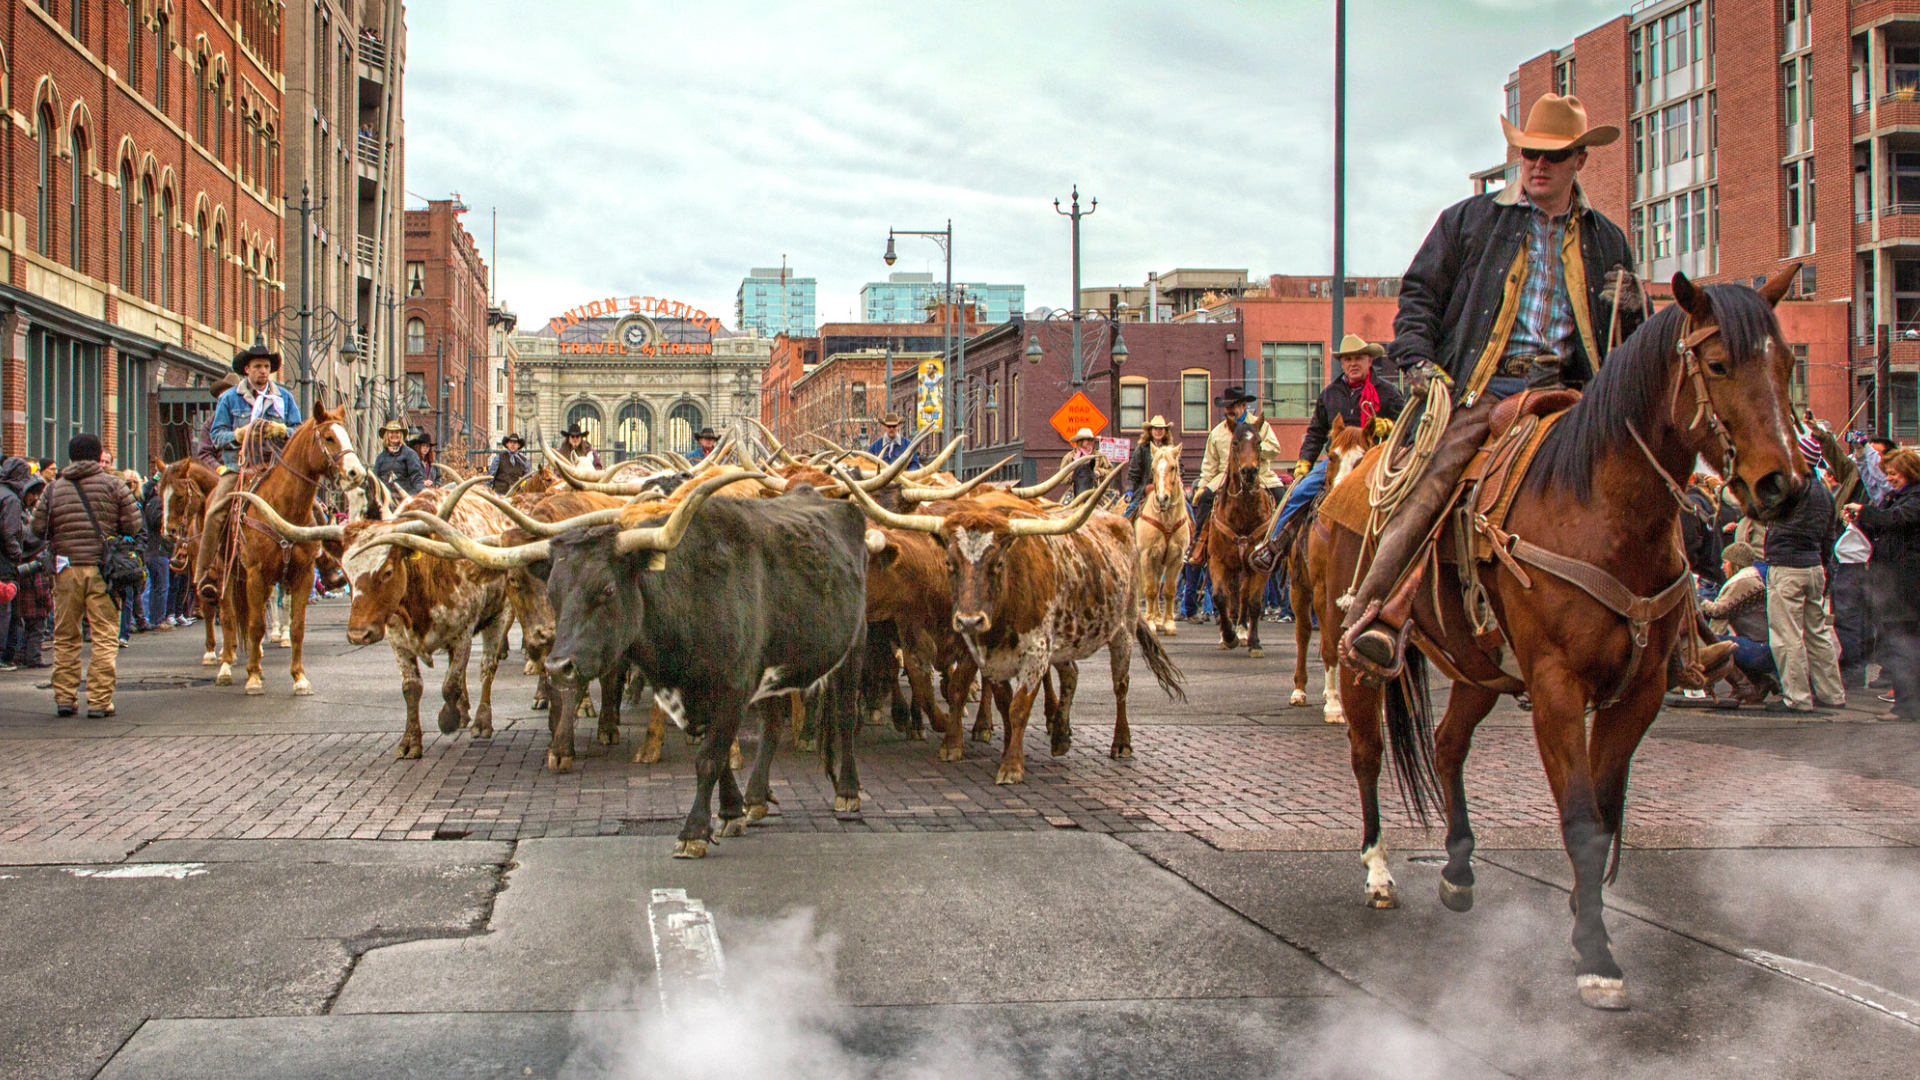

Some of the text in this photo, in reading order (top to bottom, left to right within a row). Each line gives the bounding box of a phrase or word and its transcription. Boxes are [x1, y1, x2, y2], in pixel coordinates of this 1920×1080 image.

[549, 296, 722, 336] UNION STATION
[559, 342, 712, 359] TRAVEL by TRAIN
[588, 374, 682, 384] UNION STATION
[1068, 416, 1090, 424] WORK
